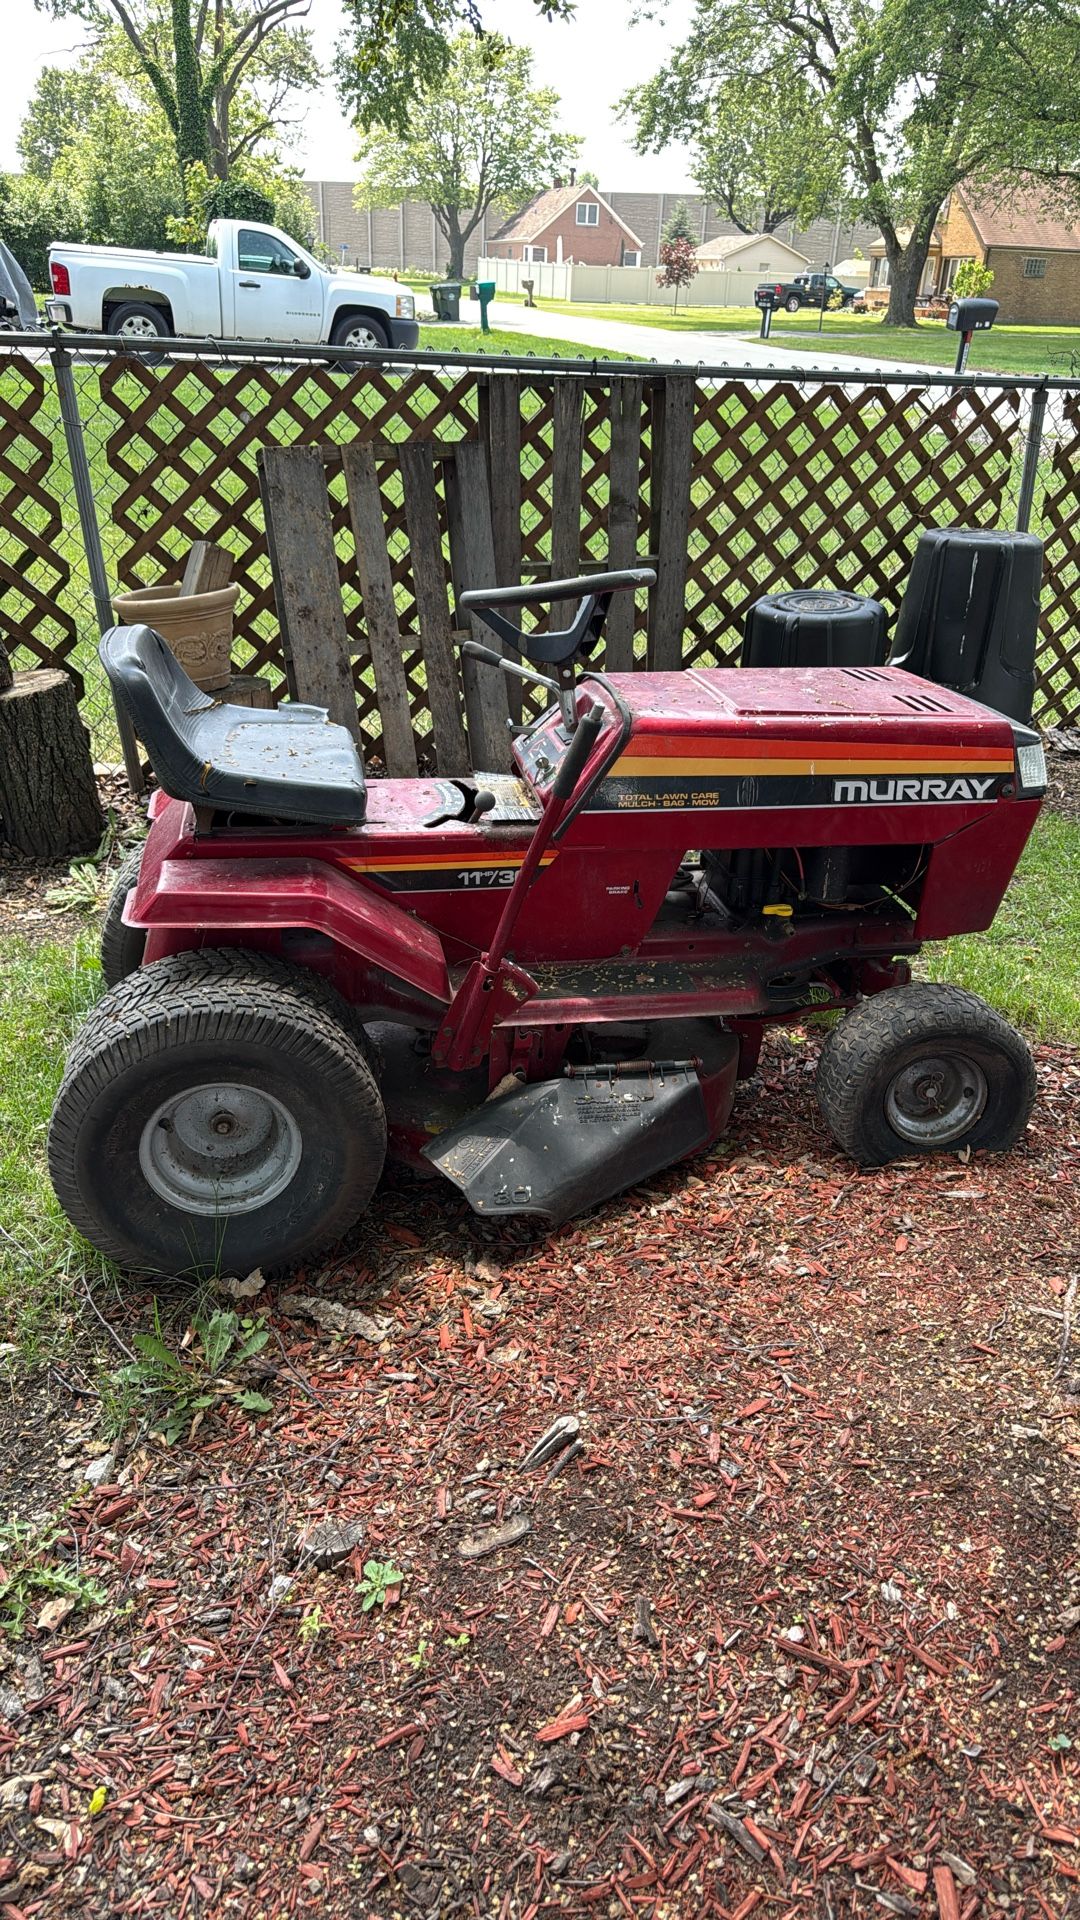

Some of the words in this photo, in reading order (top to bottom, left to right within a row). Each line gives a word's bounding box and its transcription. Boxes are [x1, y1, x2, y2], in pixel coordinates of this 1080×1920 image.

[834, 778, 996, 802] MURRAY
[618, 793, 653, 801] TOTAL
[655, 792, 689, 800] LAWN
[618, 800, 656, 808] MULCH
[457, 870, 521, 886] 11HP/3
